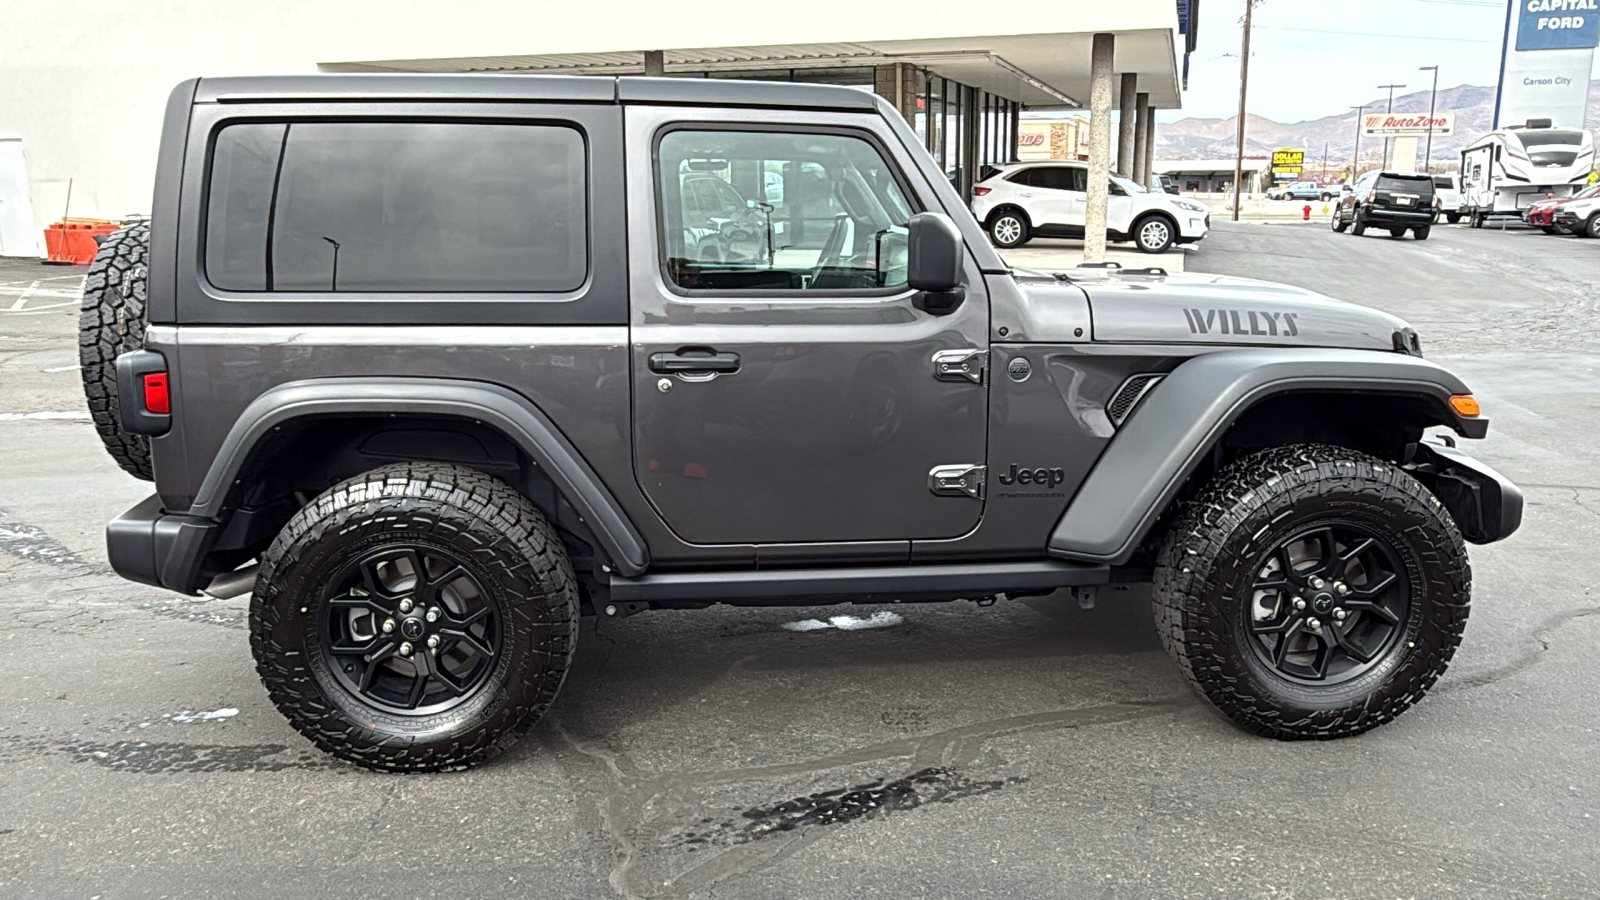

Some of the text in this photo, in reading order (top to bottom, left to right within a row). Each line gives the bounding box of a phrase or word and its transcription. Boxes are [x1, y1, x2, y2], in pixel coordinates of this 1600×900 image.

[1527, 0, 1598, 12] CAPITAL
[1538, 16, 1584, 29] FORD
[1523, 77, 1572, 86] Carson City
[1382, 116, 1447, 127] AutoZone
[1273, 152, 1303, 160] DOLLAR
[1182, 308, 1298, 337] WILLYS
[998, 462, 1065, 489] Jeep
